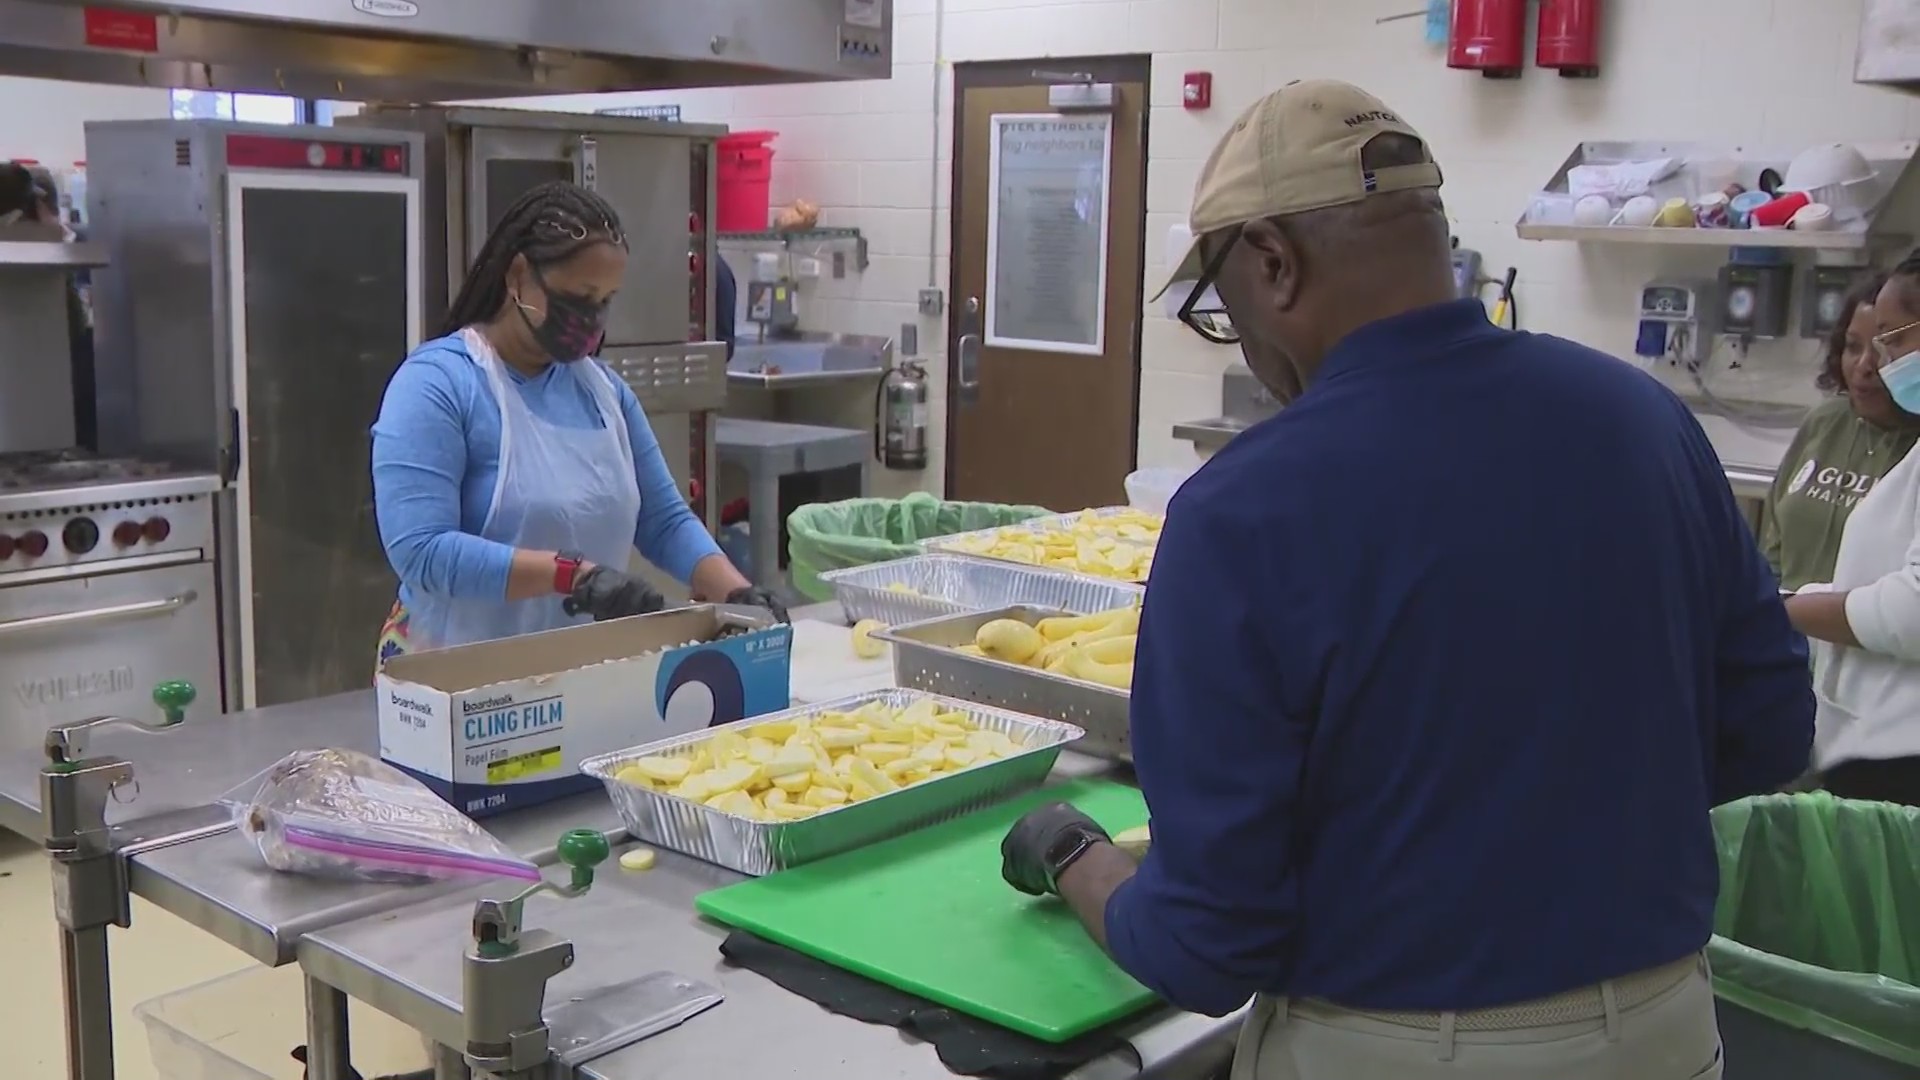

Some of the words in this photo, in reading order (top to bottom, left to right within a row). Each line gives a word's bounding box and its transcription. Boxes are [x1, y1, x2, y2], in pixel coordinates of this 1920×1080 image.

[391, 691, 433, 716] boardwalk
[463, 694, 512, 712] boardwalk
[464, 709, 517, 741] CLING
[523, 700, 563, 729] FILM
[465, 752, 488, 768] Papel
